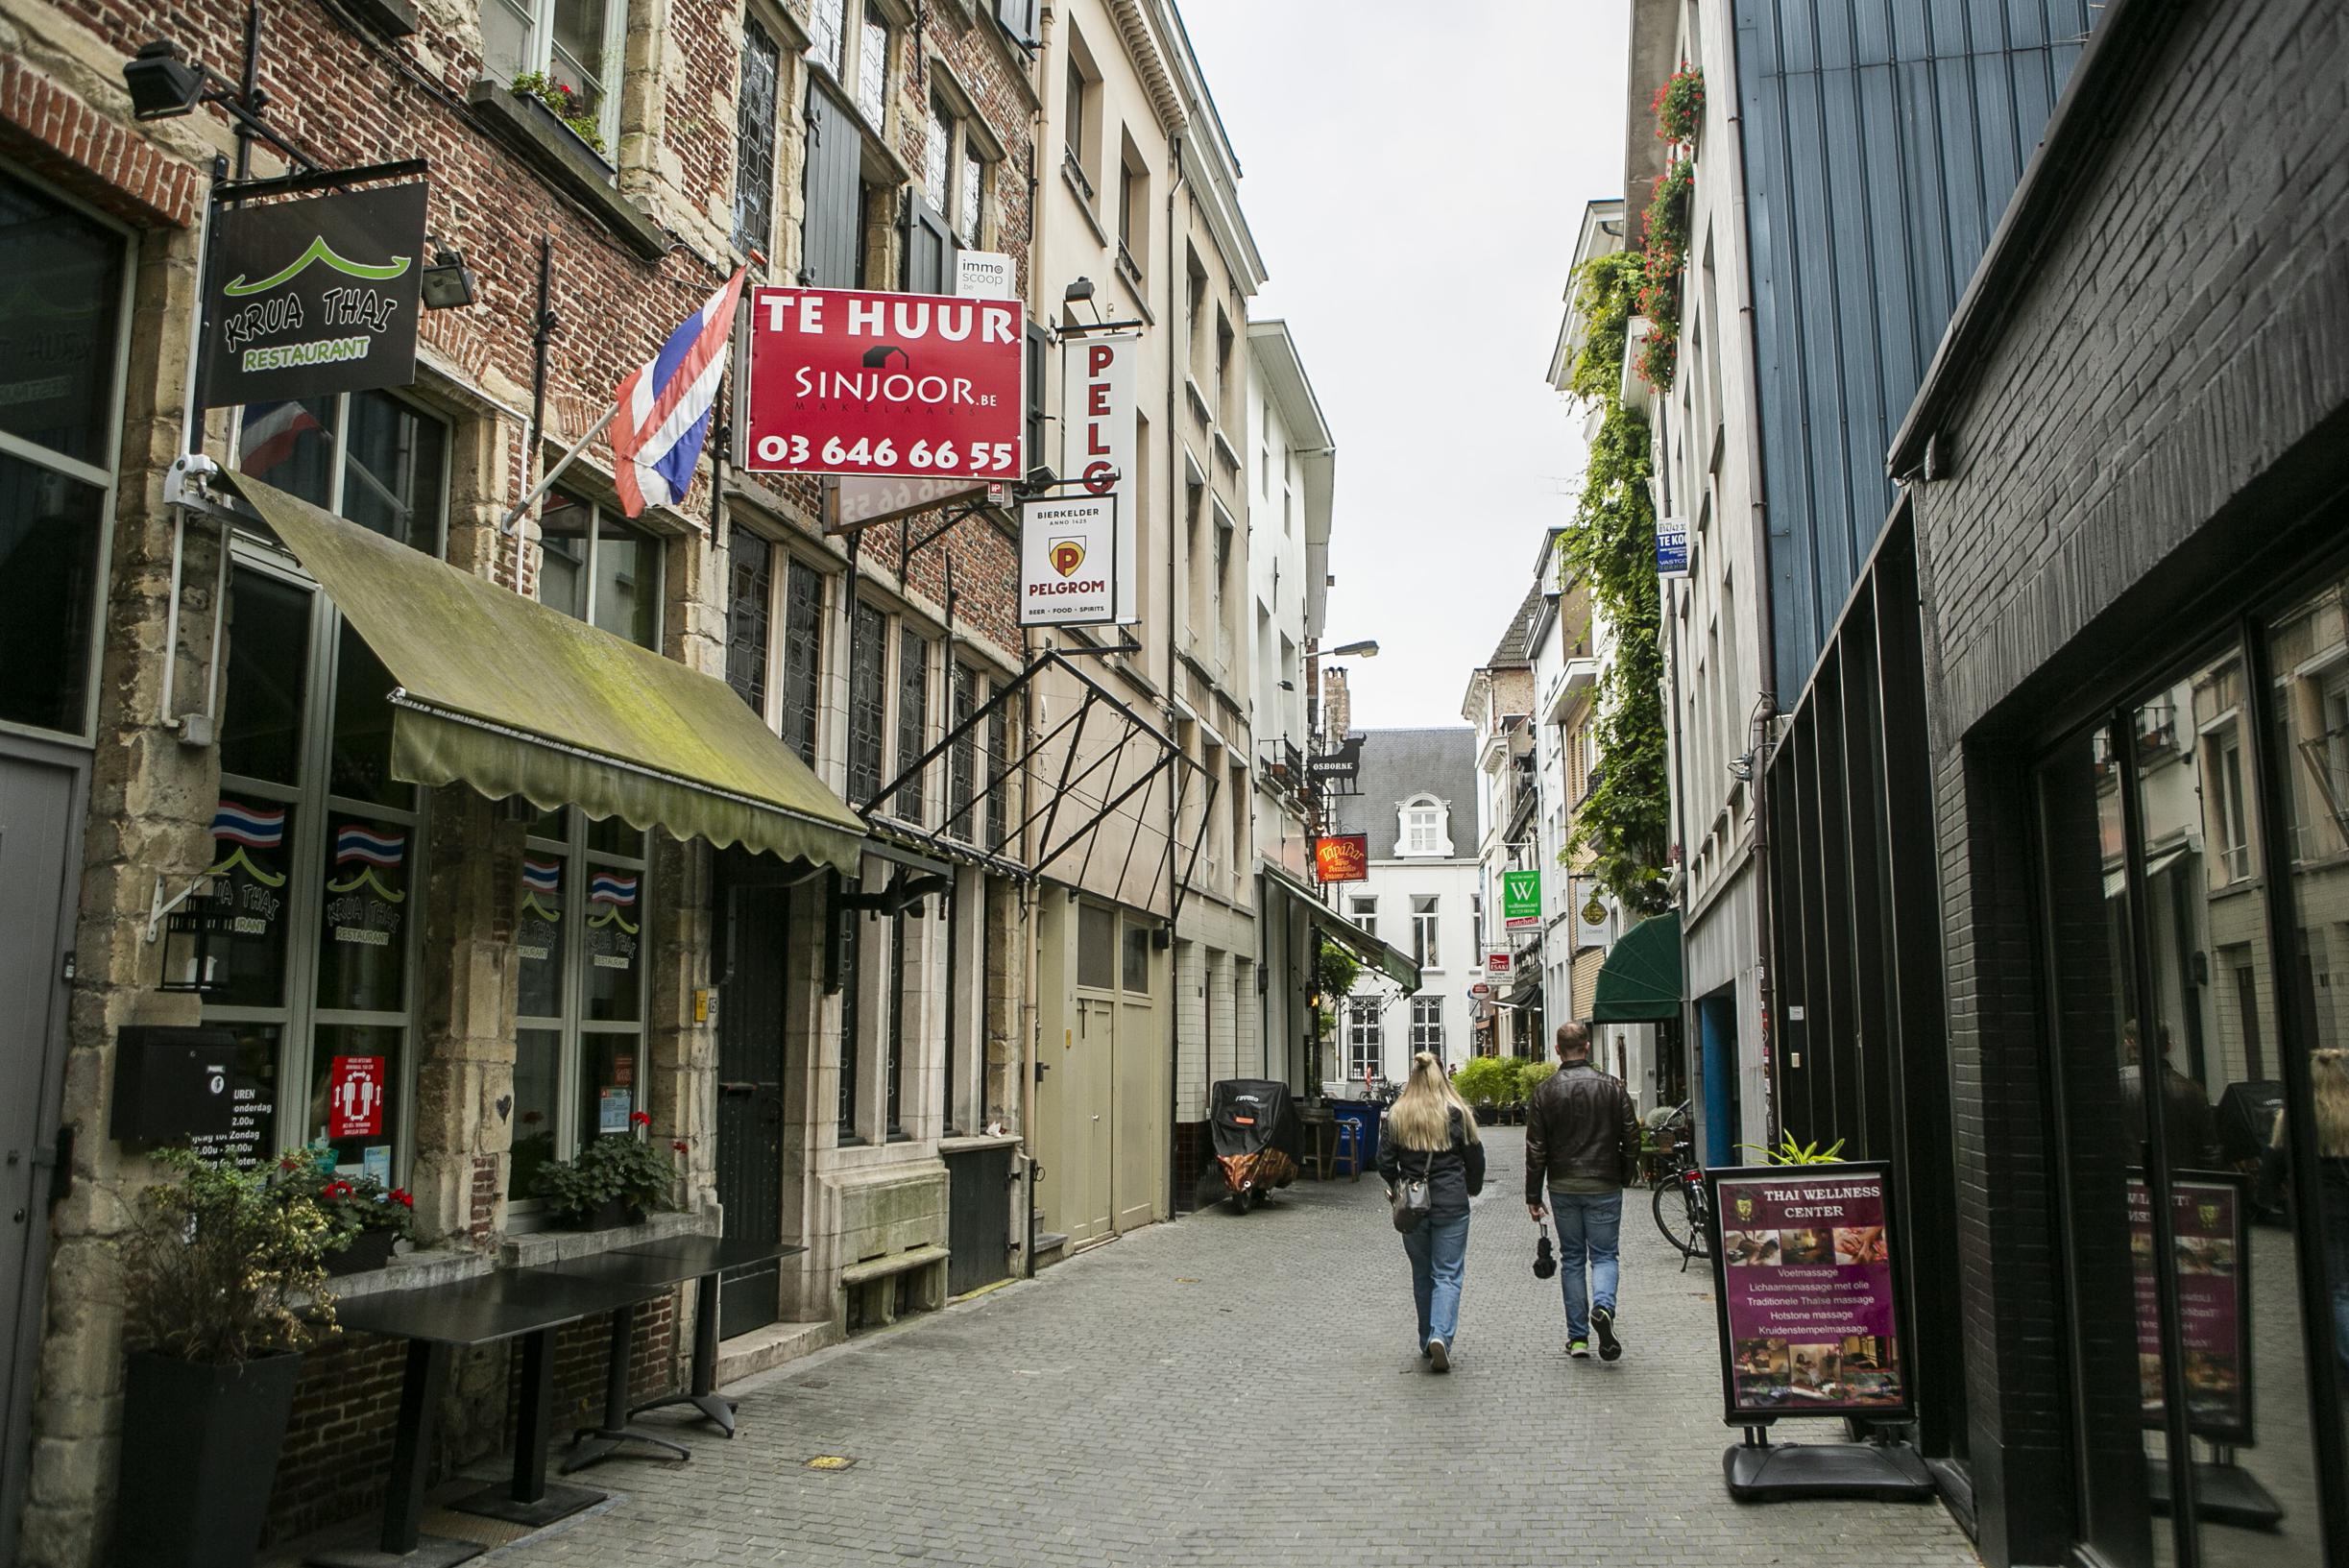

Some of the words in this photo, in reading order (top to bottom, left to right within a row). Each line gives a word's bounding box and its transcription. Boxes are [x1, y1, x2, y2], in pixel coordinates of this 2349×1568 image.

[962, 259, 1004, 274] immo
[962, 273, 1004, 287] scoop
[225, 292, 303, 352] KRUA
[323, 287, 398, 333] THAI
[761, 295, 823, 334] TE
[848, 300, 1015, 345] HUUR
[242, 335, 371, 373] RESTAURANT
[795, 401, 976, 417] MAKELAARS
[1082, 345, 1116, 494] PELG
[757, 435, 810, 464] 03
[821, 436, 898, 468] 646
[908, 439, 958, 469] 66
[970, 442, 1012, 470] 55
[1037, 508, 1100, 519] BIERKELDER
[1659, 536, 1671, 546] TE
[1671, 534, 1684, 545] KO
[1029, 580, 1104, 596] PELGROM
[1511, 881, 1535, 901] W
[242, 883, 280, 921] THAI
[327, 896, 362, 927] KRUA
[369, 900, 400, 932] THAI
[335, 927, 390, 945] RESTAURANT
[233, 1103, 272, 1113] onderdag
[231, 1117, 254, 1126] 2.00u
[230, 1130, 260, 1141] Zondag
[1764, 1190, 1800, 1201] THAI
[1803, 1186, 1880, 1200] WELLNESS
[1784, 1206, 1844, 1218] CENTER
[1778, 1268, 1838, 1278] Voetmassage
[1750, 1283, 1832, 1292] Lichaamsmassage
[1747, 1297, 1798, 1306] Traditionele
[1833, 1296, 1875, 1305] massage
[1771, 1311, 1810, 1319] Hotstone
[1812, 1310, 1853, 1319] massage
[1758, 1325, 1868, 1336] Kruidenstempelmassage
